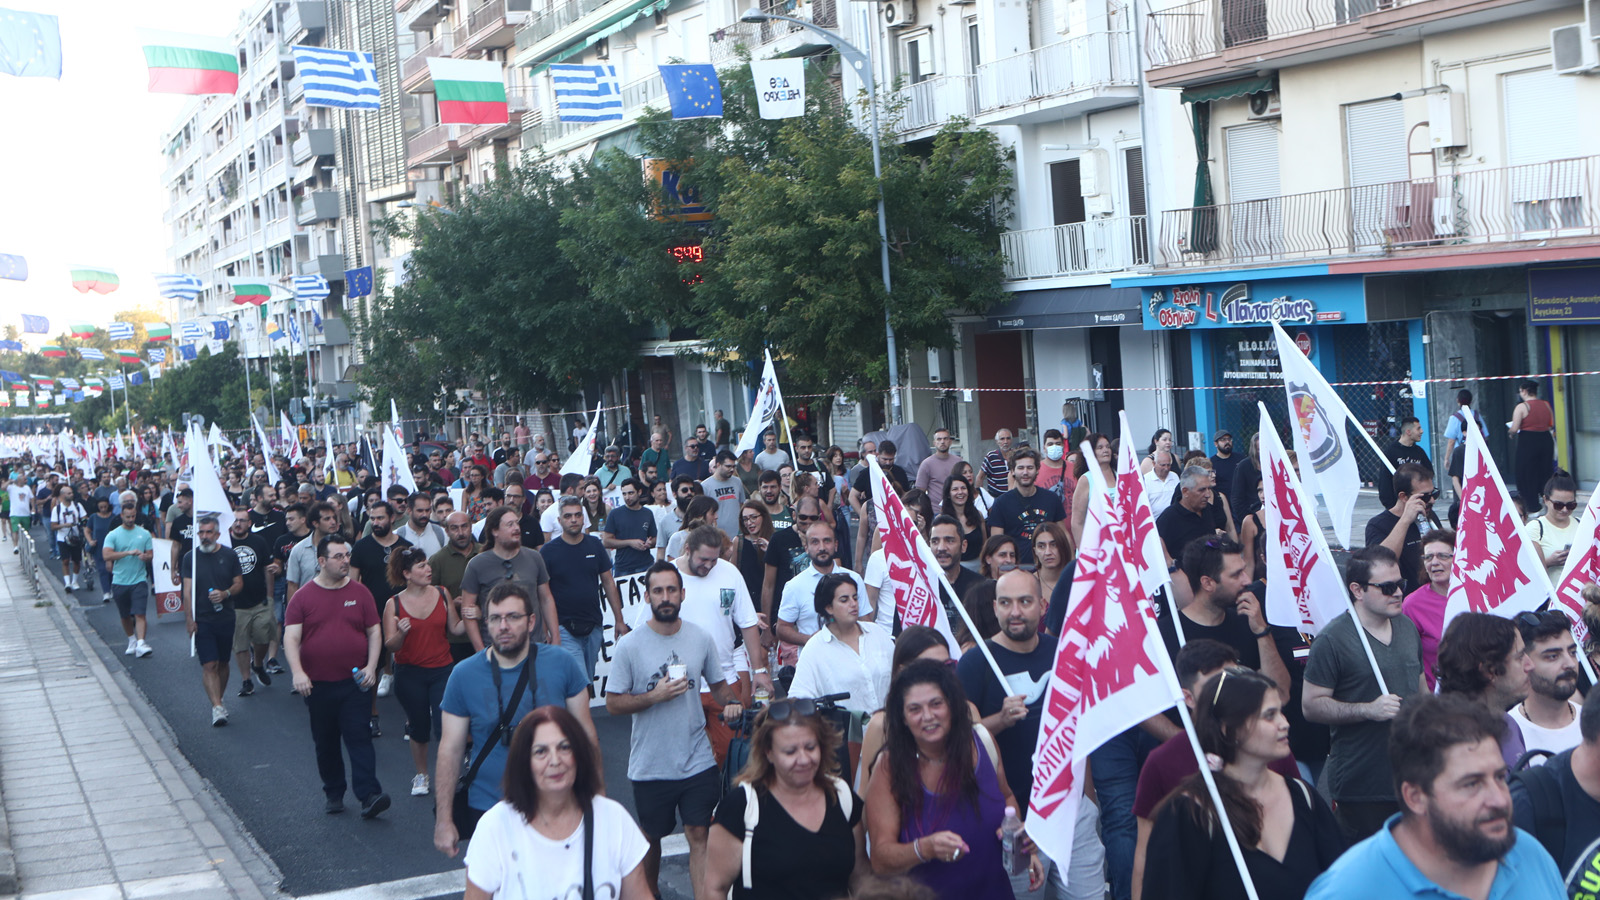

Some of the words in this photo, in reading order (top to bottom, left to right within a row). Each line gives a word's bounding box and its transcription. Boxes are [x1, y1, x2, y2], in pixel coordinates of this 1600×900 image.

[1172, 287, 1201, 307] Σχολή
[1533, 296, 1569, 306] Ενοικιάσεις
[1159, 308, 1196, 328] Οδηγών
[1297, 341, 1310, 350] STOP
[1239, 358, 1266, 367] ΣΕΜΙΝΑΡΙΑ
[714, 486, 736, 497] NIKE
